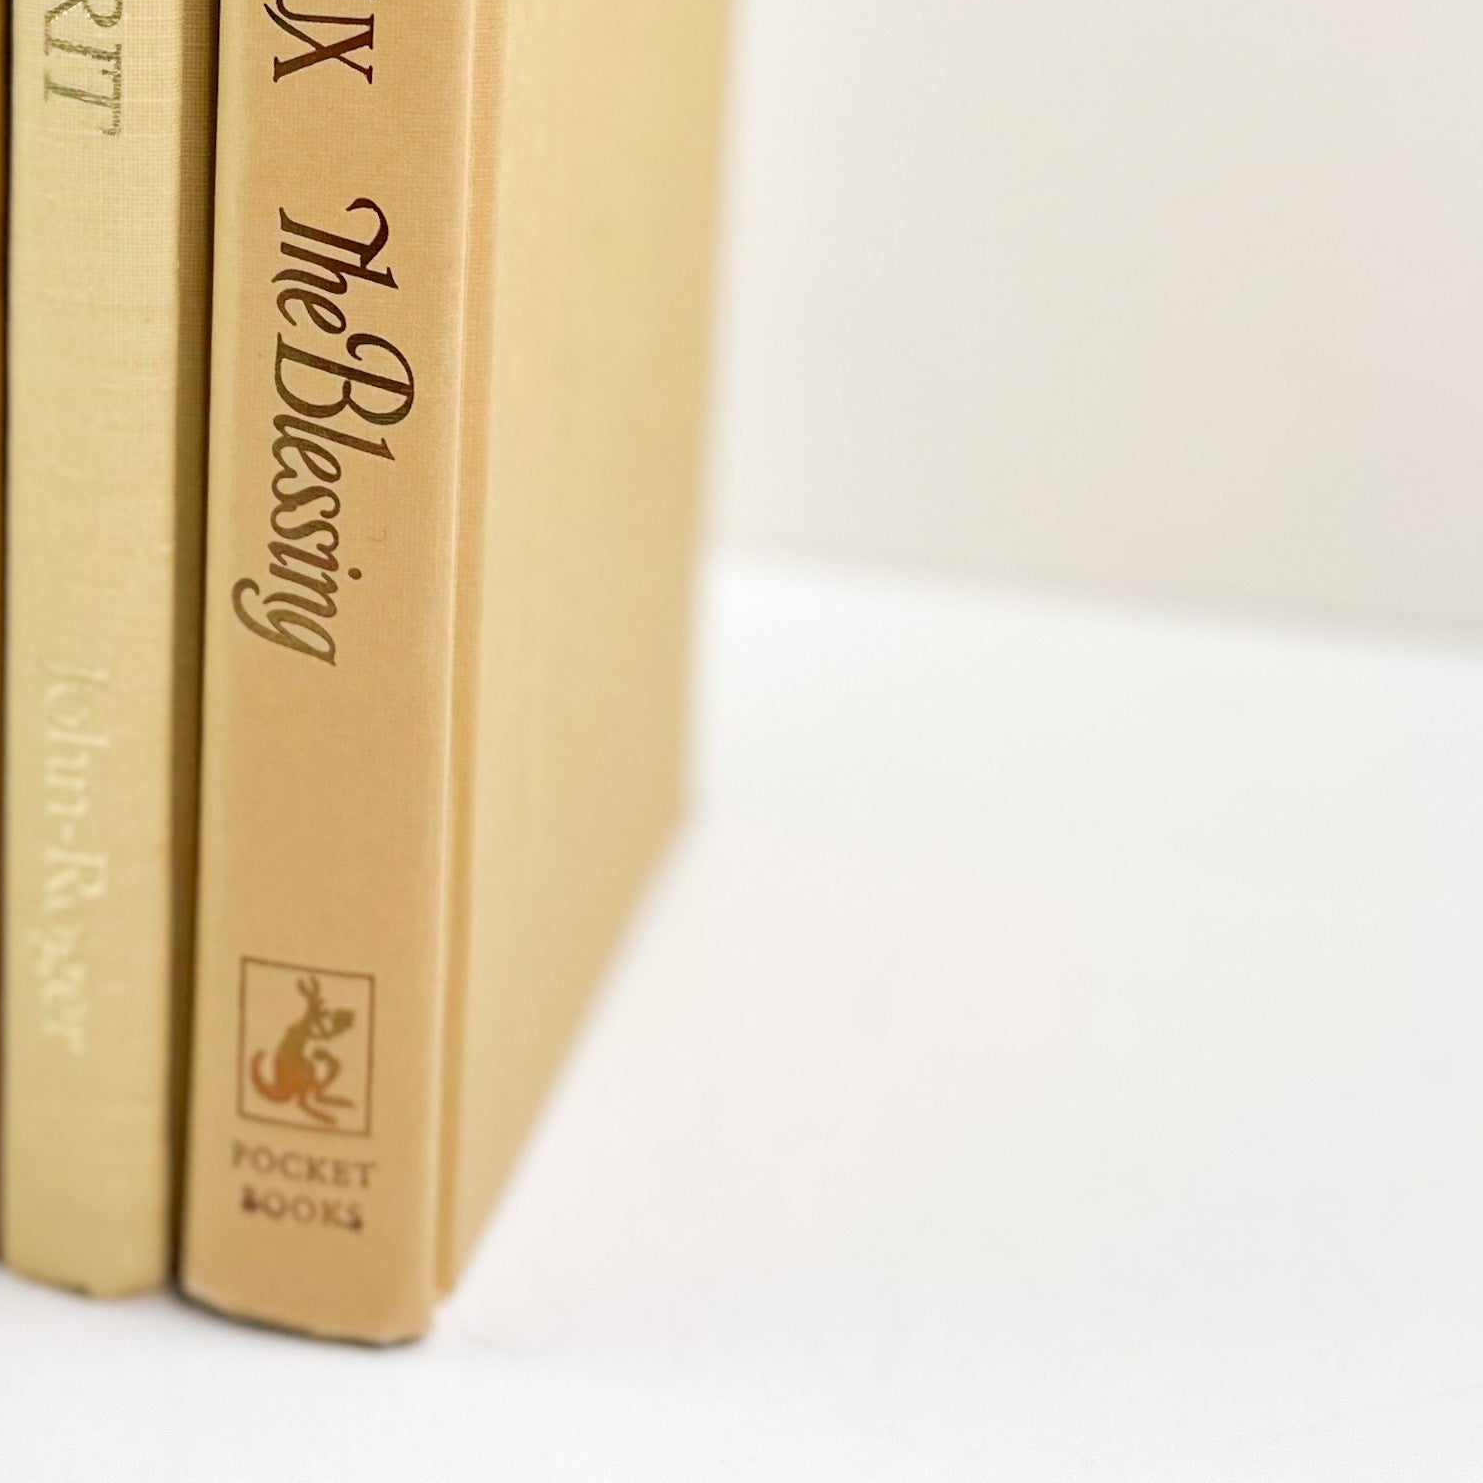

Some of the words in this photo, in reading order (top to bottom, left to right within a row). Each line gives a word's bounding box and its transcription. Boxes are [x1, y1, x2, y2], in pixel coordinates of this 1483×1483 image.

[271, 197, 399, 327] The
[231, 332, 416, 667] Blessing
[231, 1140, 377, 1189] POCKET
[239, 1184, 364, 1231] BOOKS
